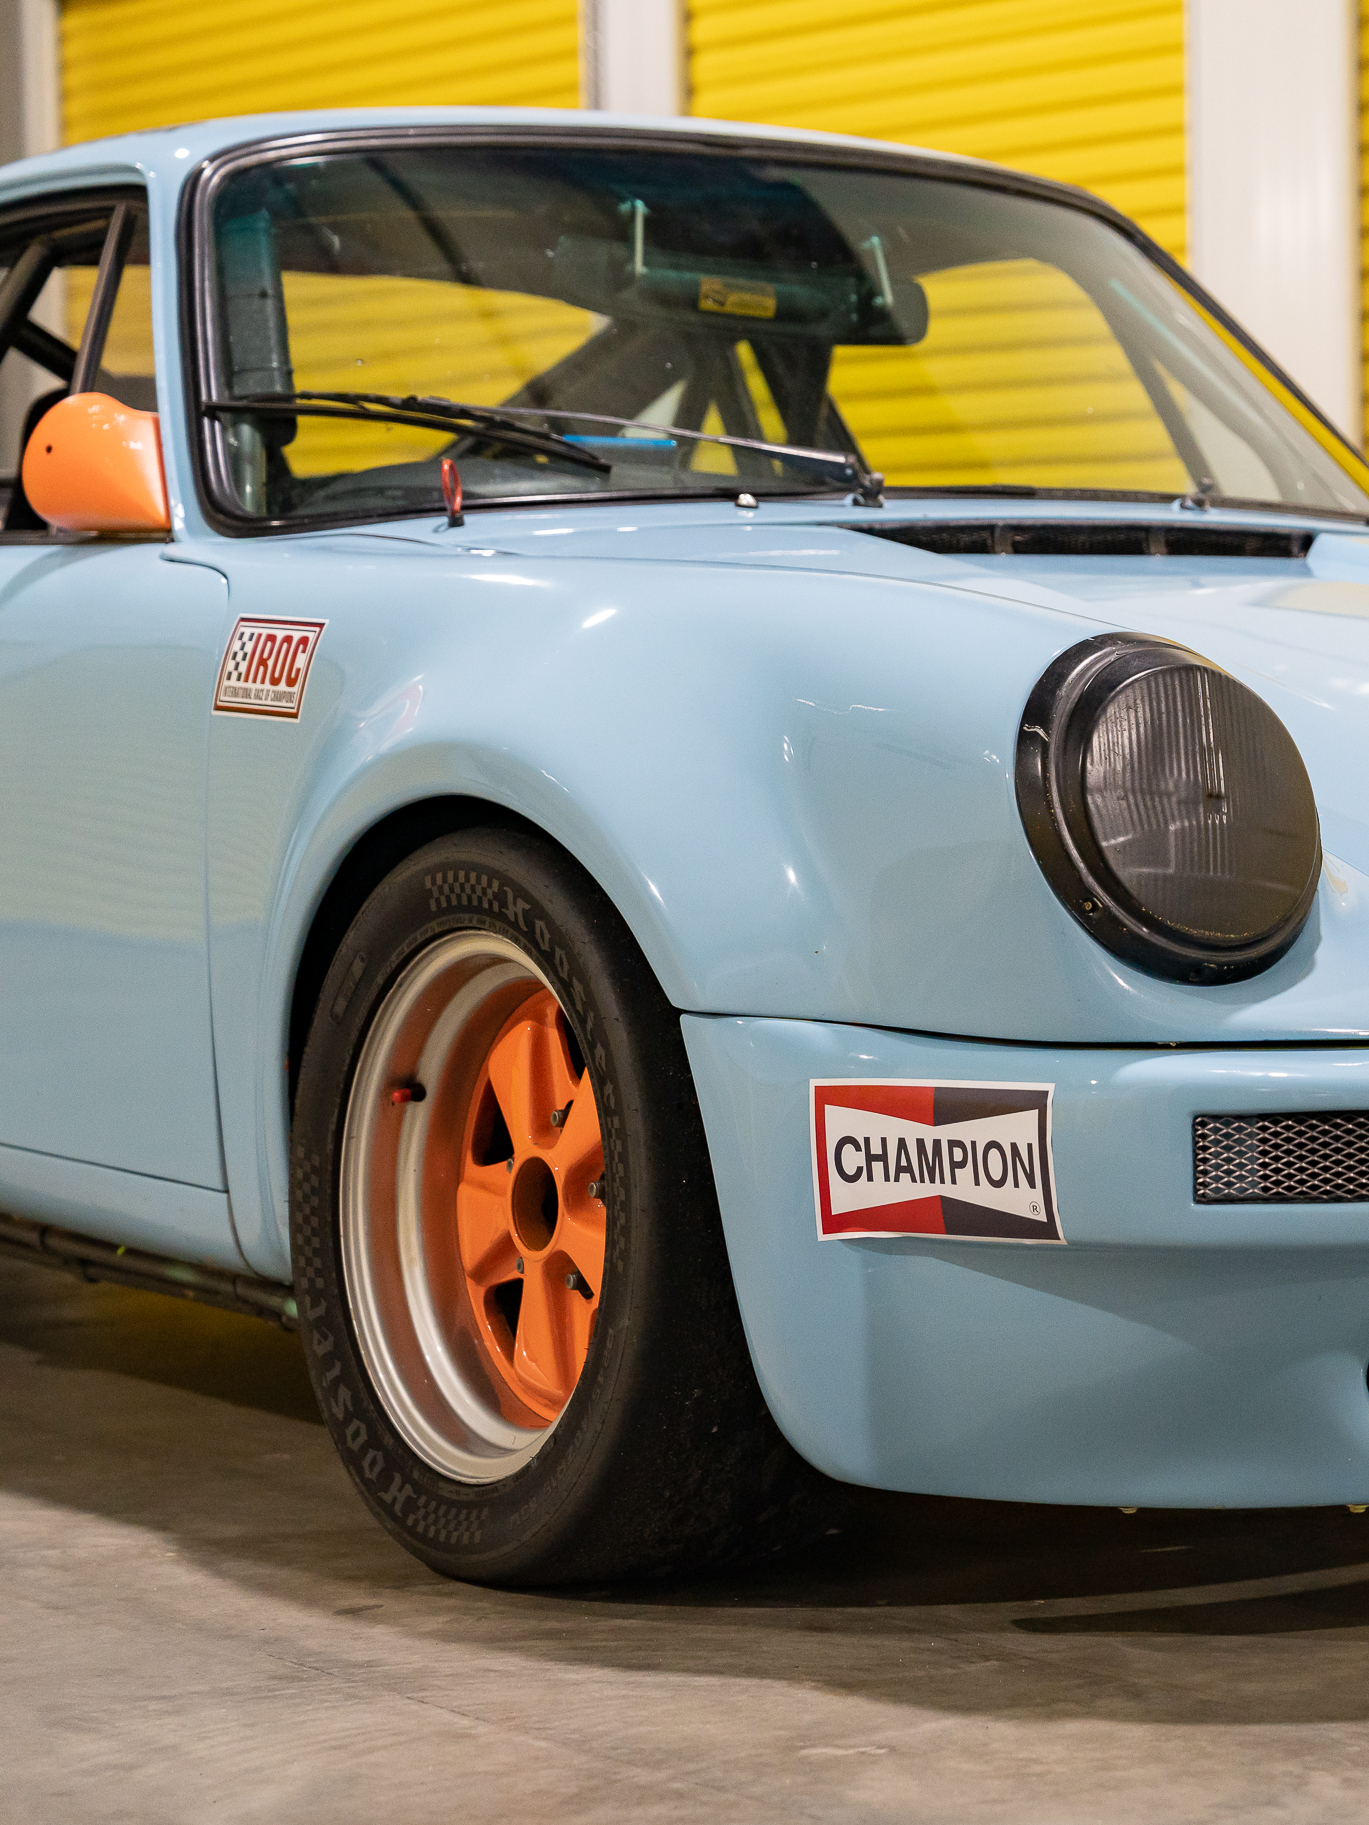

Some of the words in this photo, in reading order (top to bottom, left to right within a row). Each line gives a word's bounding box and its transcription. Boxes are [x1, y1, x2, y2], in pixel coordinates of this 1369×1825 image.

[243, 633, 310, 688] IROC
[833, 1134, 1038, 1190] CHAMPION
[304, 1293, 420, 1518] Hoosier
